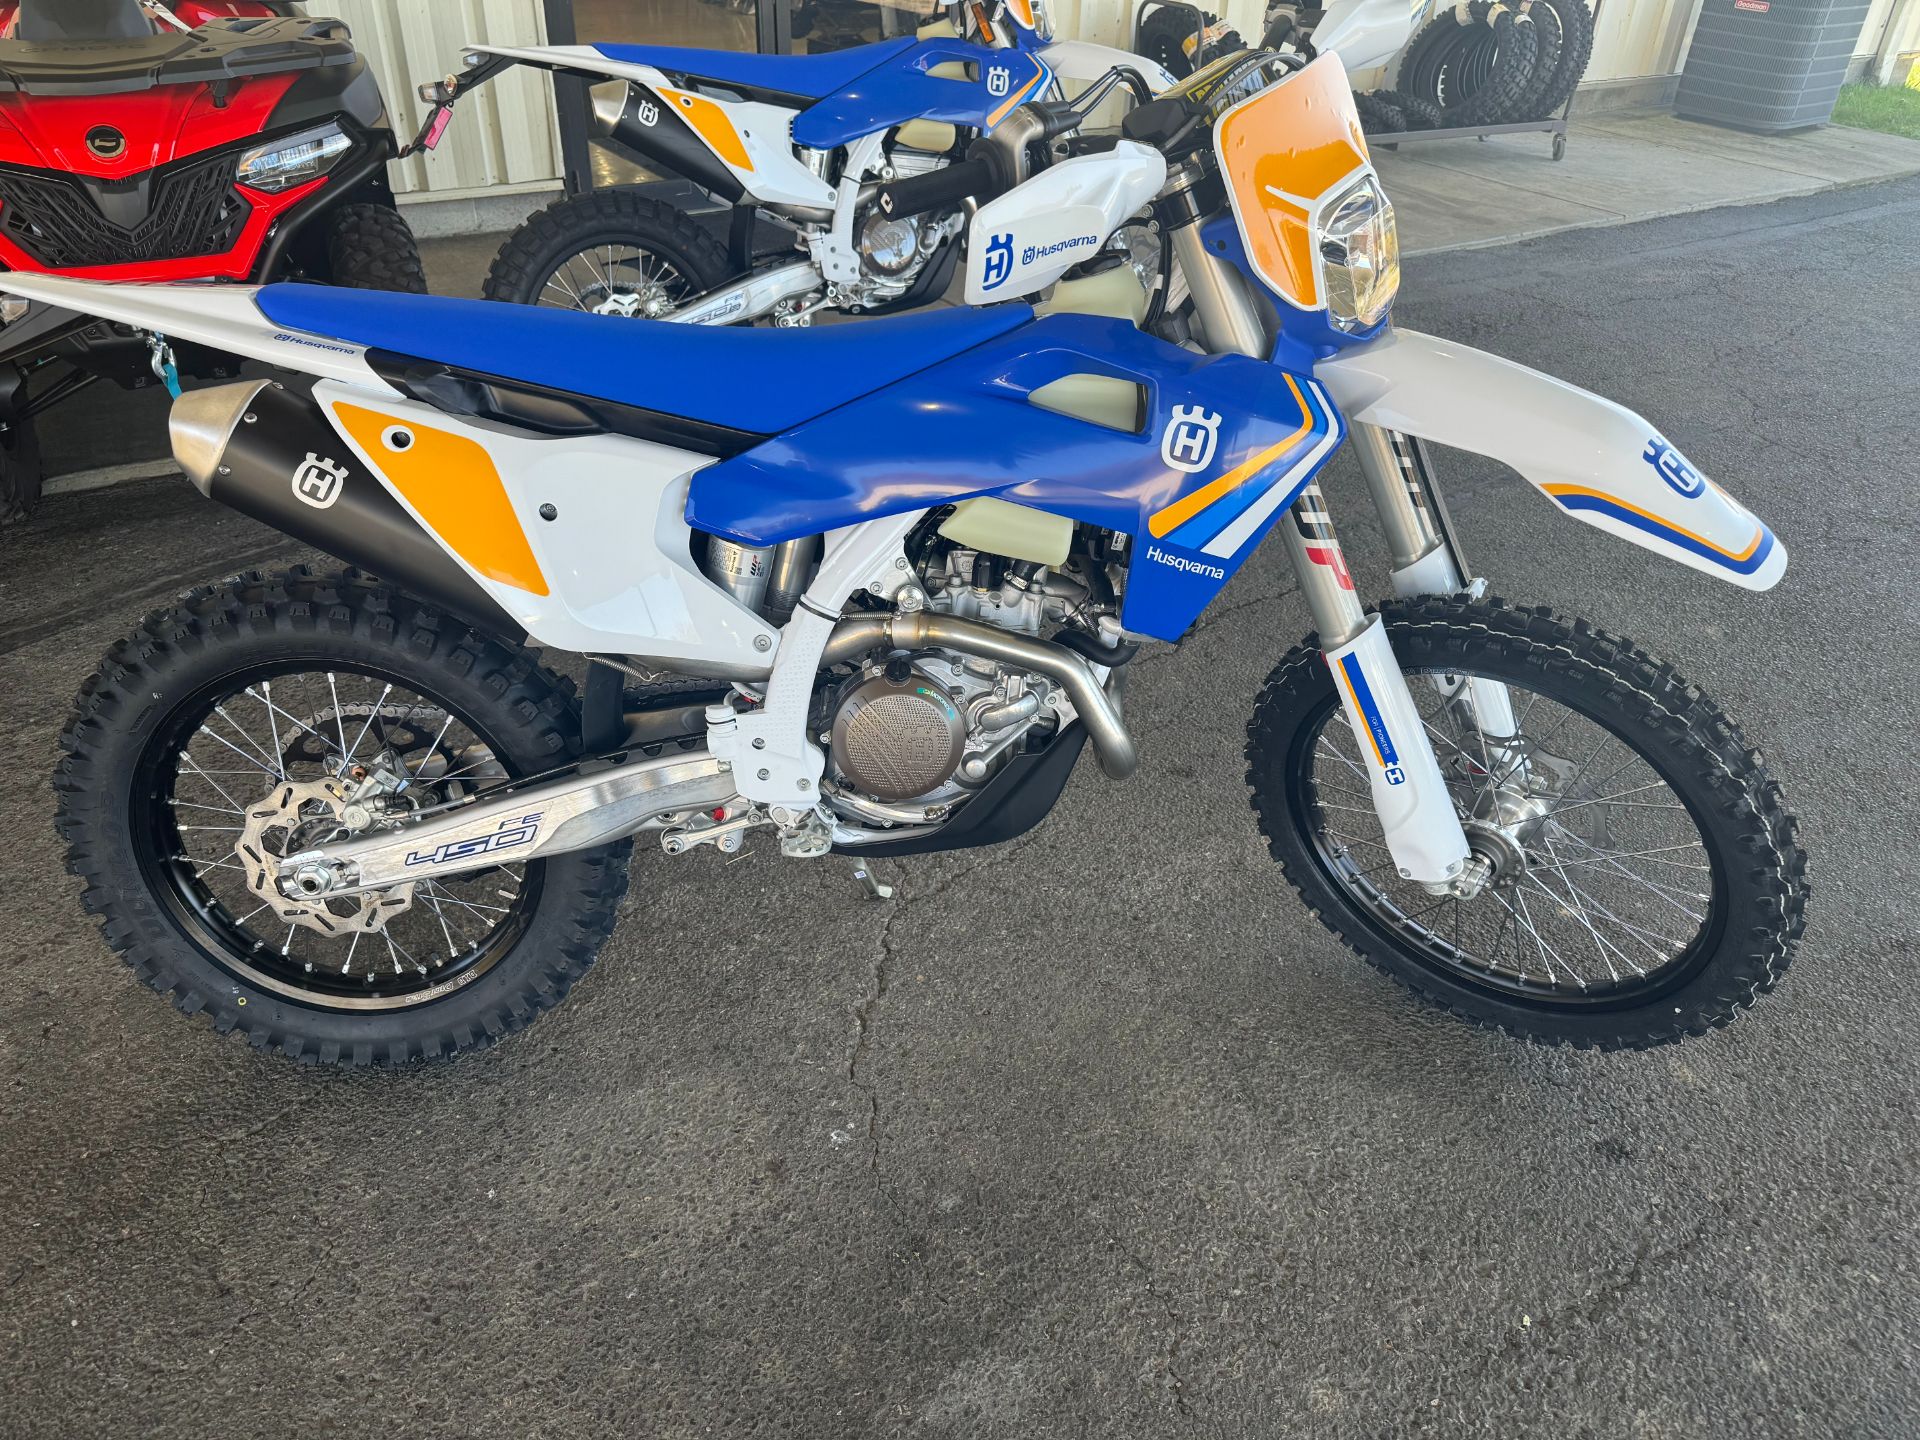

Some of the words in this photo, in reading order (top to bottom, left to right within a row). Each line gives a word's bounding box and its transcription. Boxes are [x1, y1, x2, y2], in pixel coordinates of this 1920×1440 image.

[1737, 0, 1767, 10] Goodman
[1036, 235, 1097, 260] Husqvarna
[290, 337, 355, 355] Husqvarna
[1146, 545, 1225, 580] Husqvarna
[499, 811, 545, 831] FE
[405, 824, 538, 867] 450
